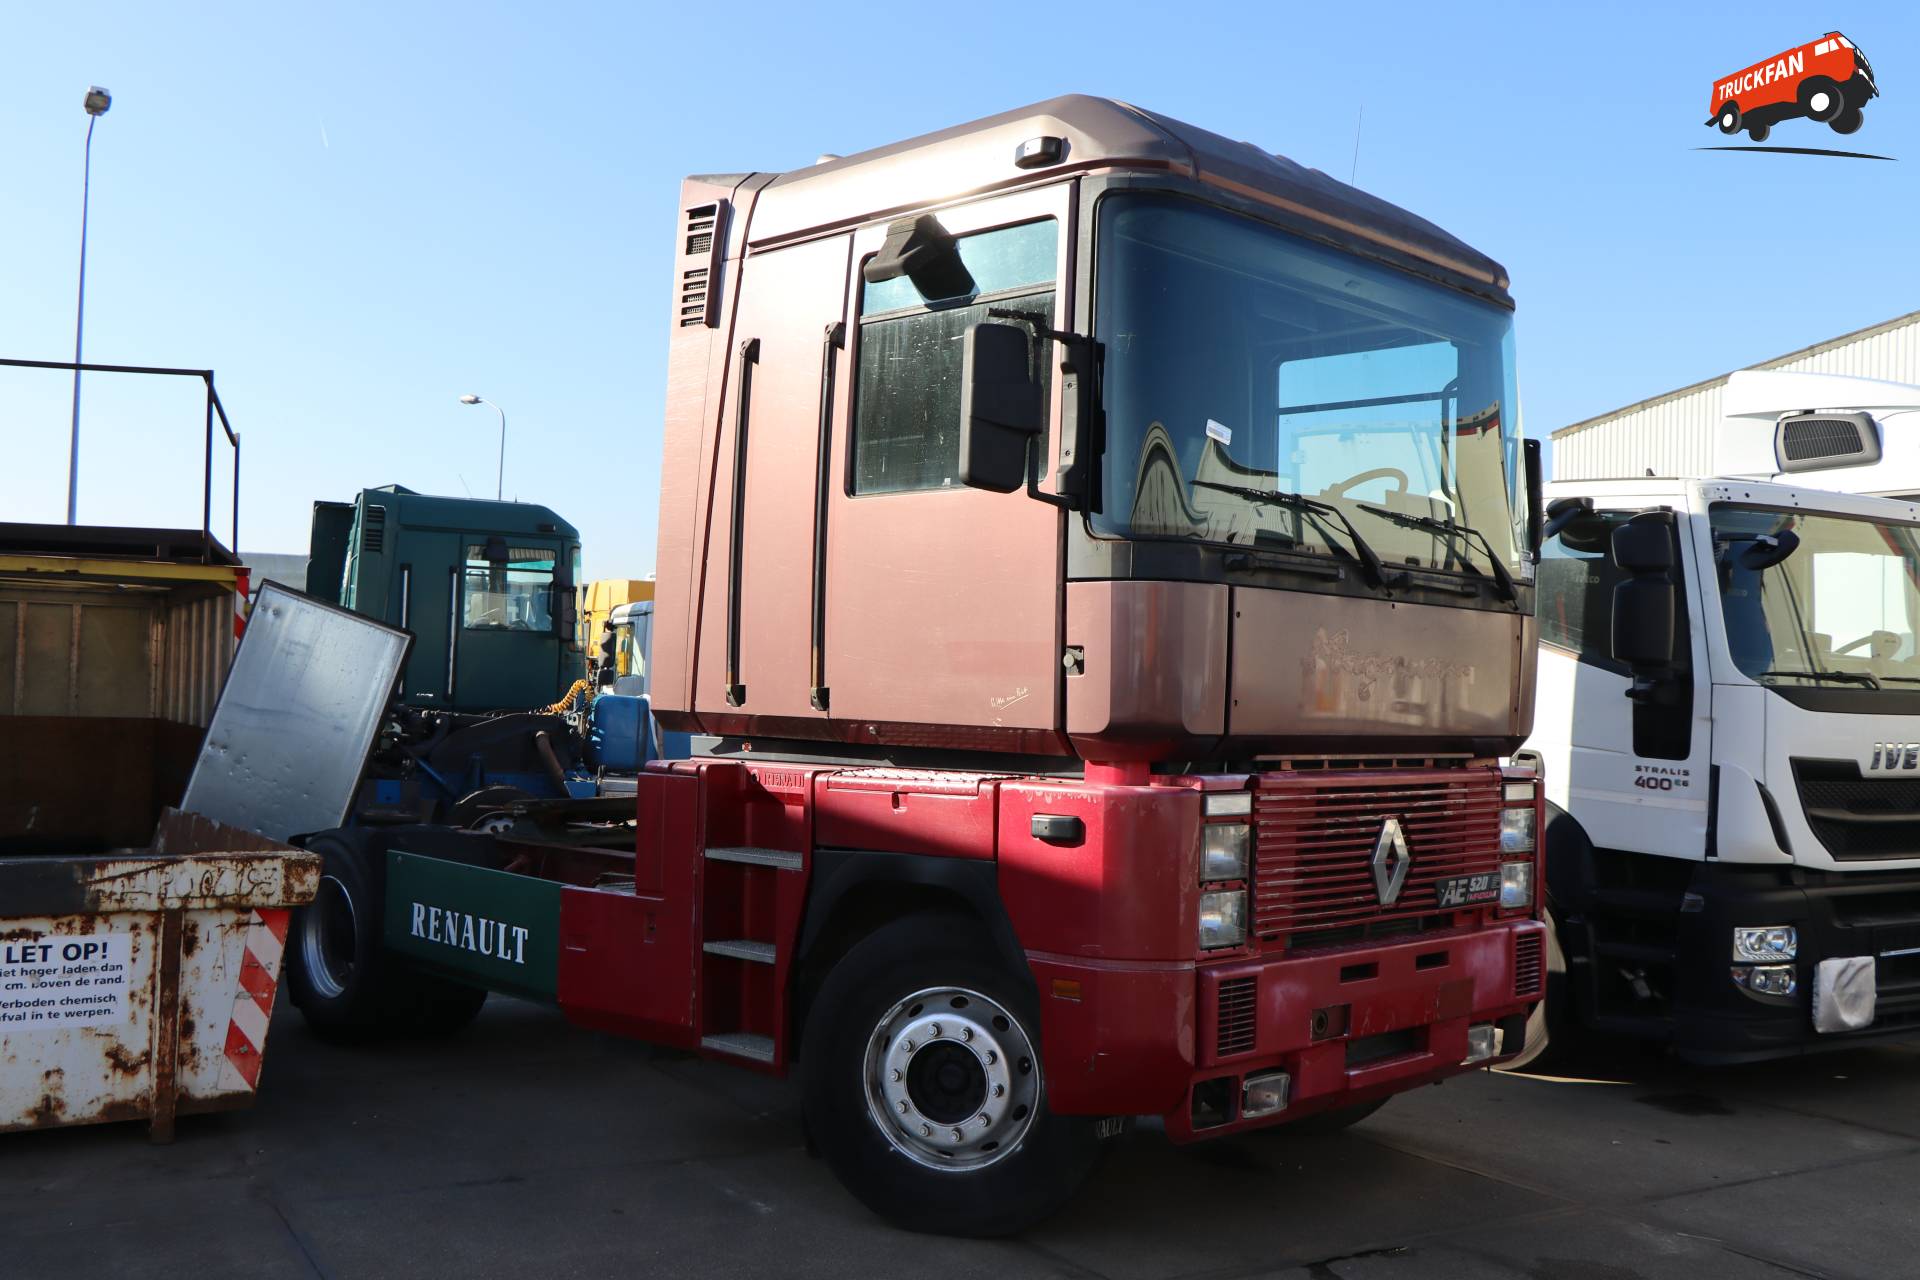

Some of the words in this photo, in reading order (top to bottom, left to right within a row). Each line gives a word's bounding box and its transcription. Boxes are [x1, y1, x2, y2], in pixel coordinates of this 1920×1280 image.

[1870, 742, 1920, 770] IVE
[1635, 765, 1690, 776] STRALIS
[1635, 775, 1672, 790] 400
[1441, 879, 1468, 905] AE
[1469, 876, 1489, 892] 520
[410, 902, 529, 964] RENAULT
[6, 944, 53, 964] LET
[62, 942, 108, 961] OP!
[21, 967, 58, 978] hoger
[63, 964, 97, 974] laden
[101, 963, 123, 972] dan
[75, 977, 90, 986] de
[94, 975, 125, 985] rand.
[60, 993, 116, 1006] chemisch
[31, 1011, 43, 1020] in
[48, 1010, 60, 1019] te
[65, 1007, 114, 1018] werpen.
